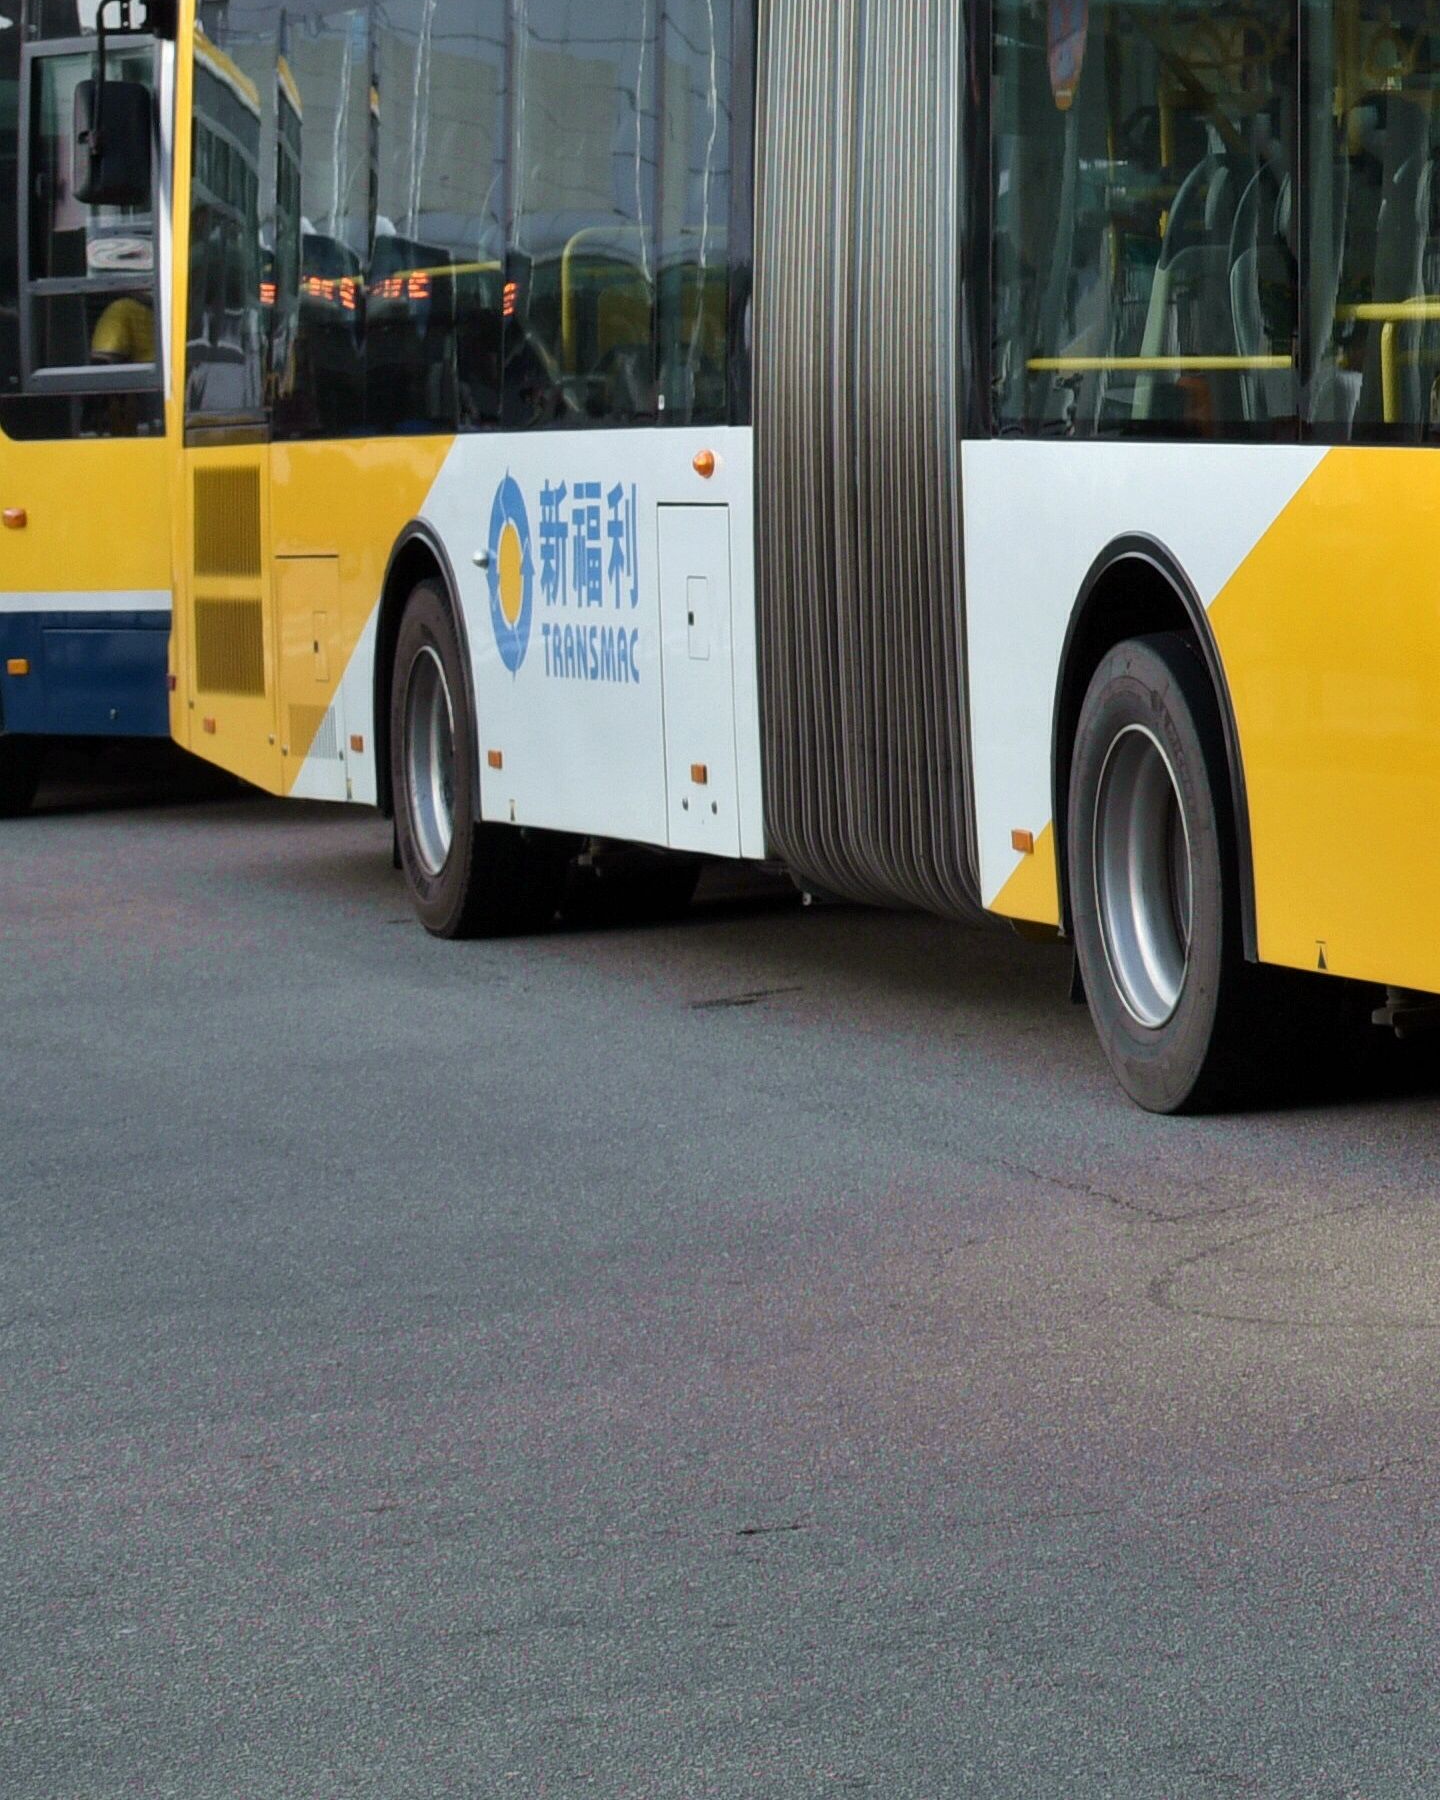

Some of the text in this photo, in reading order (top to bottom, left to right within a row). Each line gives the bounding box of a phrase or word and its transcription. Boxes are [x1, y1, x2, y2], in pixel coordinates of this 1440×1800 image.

[539, 478, 640, 610] 新福利
[541, 621, 641, 685] TRANSMAC
